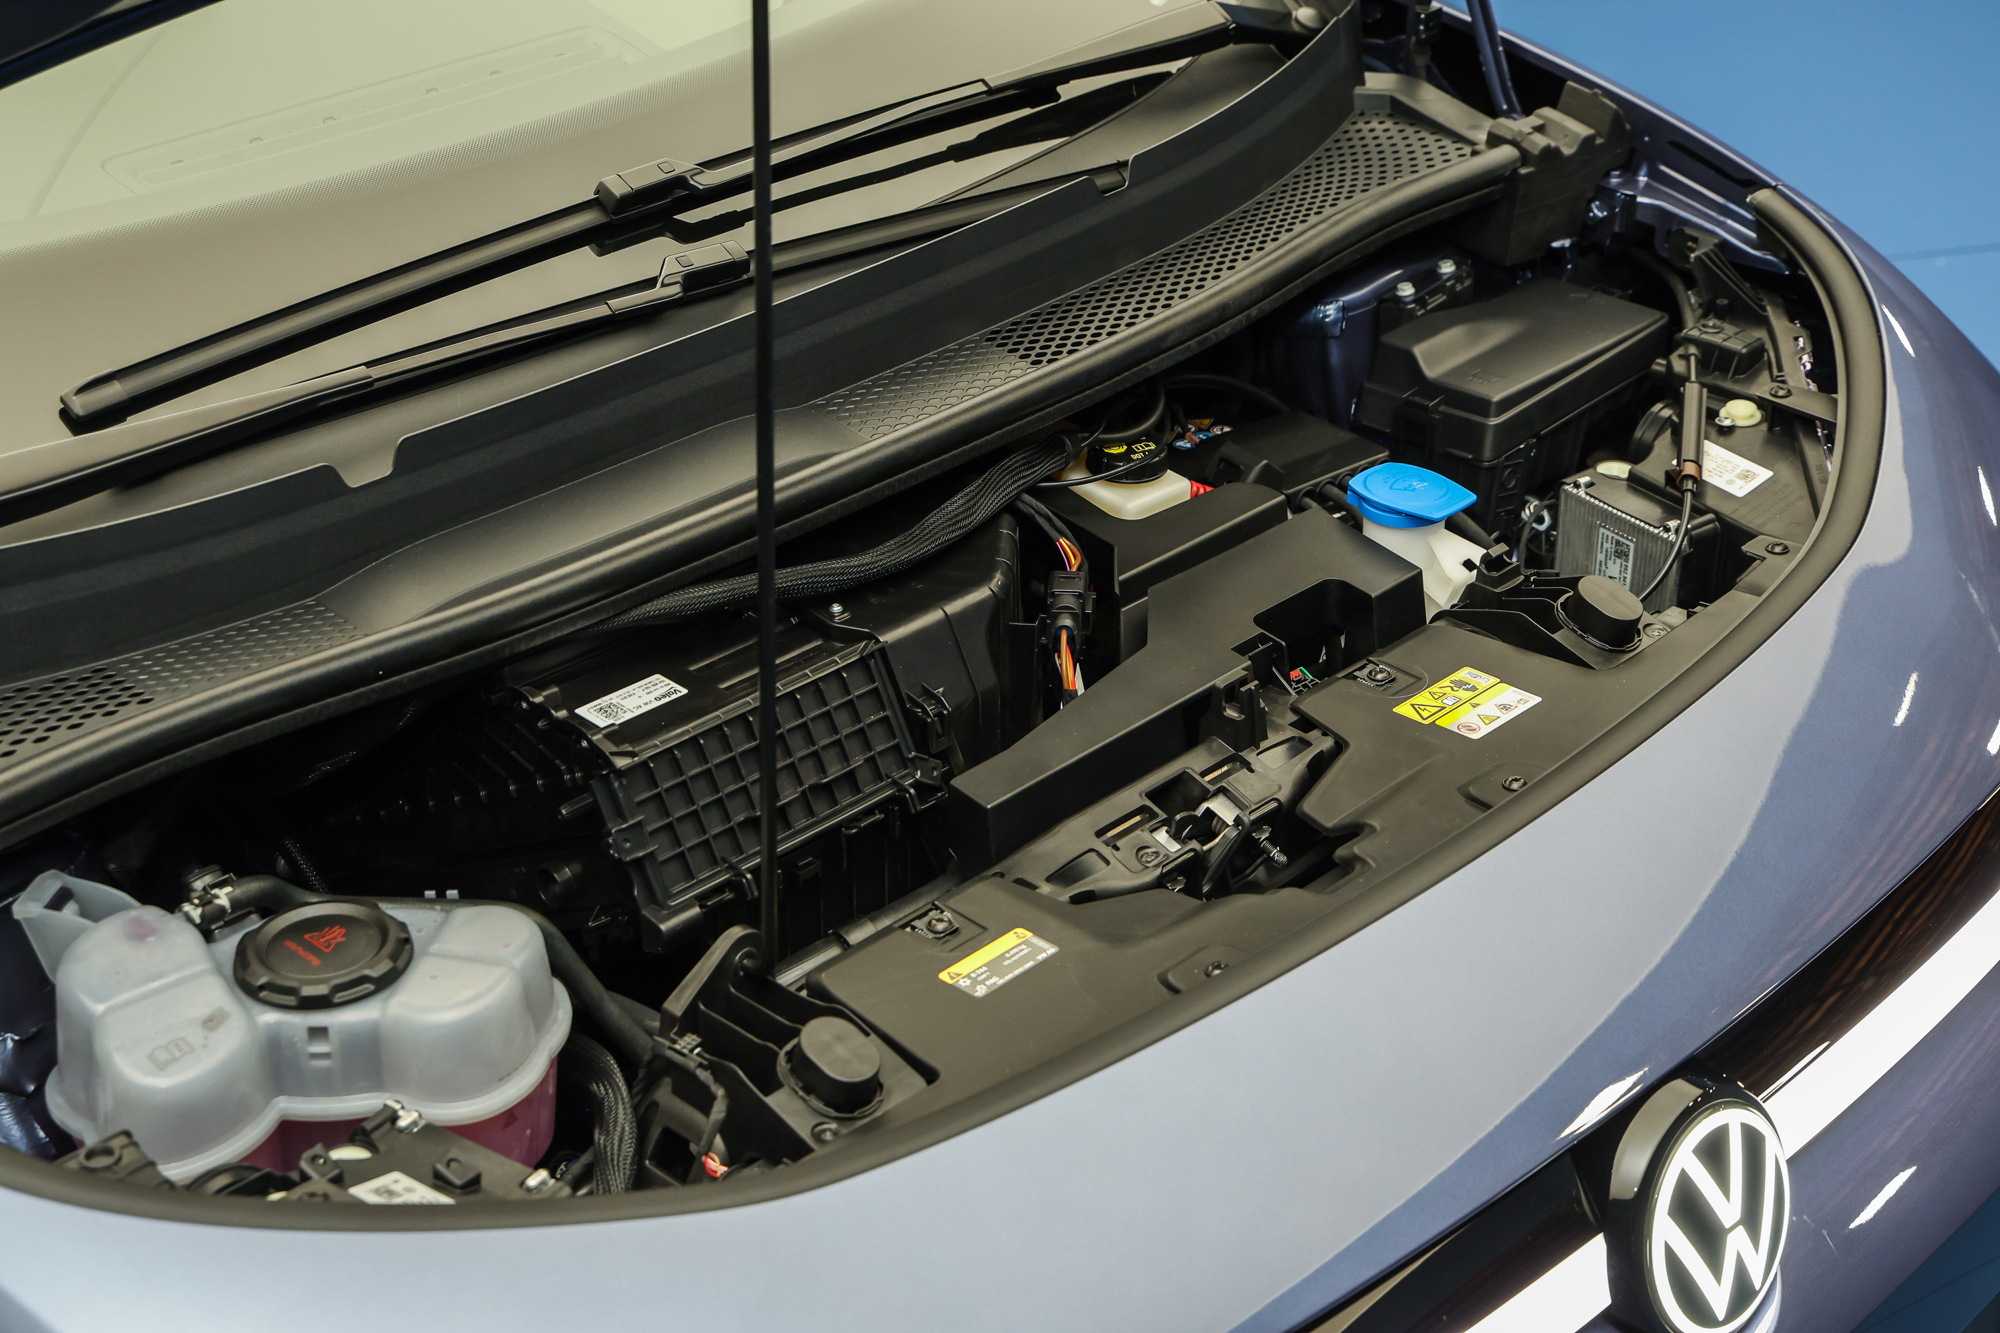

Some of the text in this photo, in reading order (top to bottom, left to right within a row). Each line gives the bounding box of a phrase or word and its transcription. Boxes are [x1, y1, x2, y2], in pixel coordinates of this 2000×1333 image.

[1130, 452, 1144, 460] DOT
[654, 687, 682, 702] Valeo
[1656, 1113, 1786, 1327] VW
